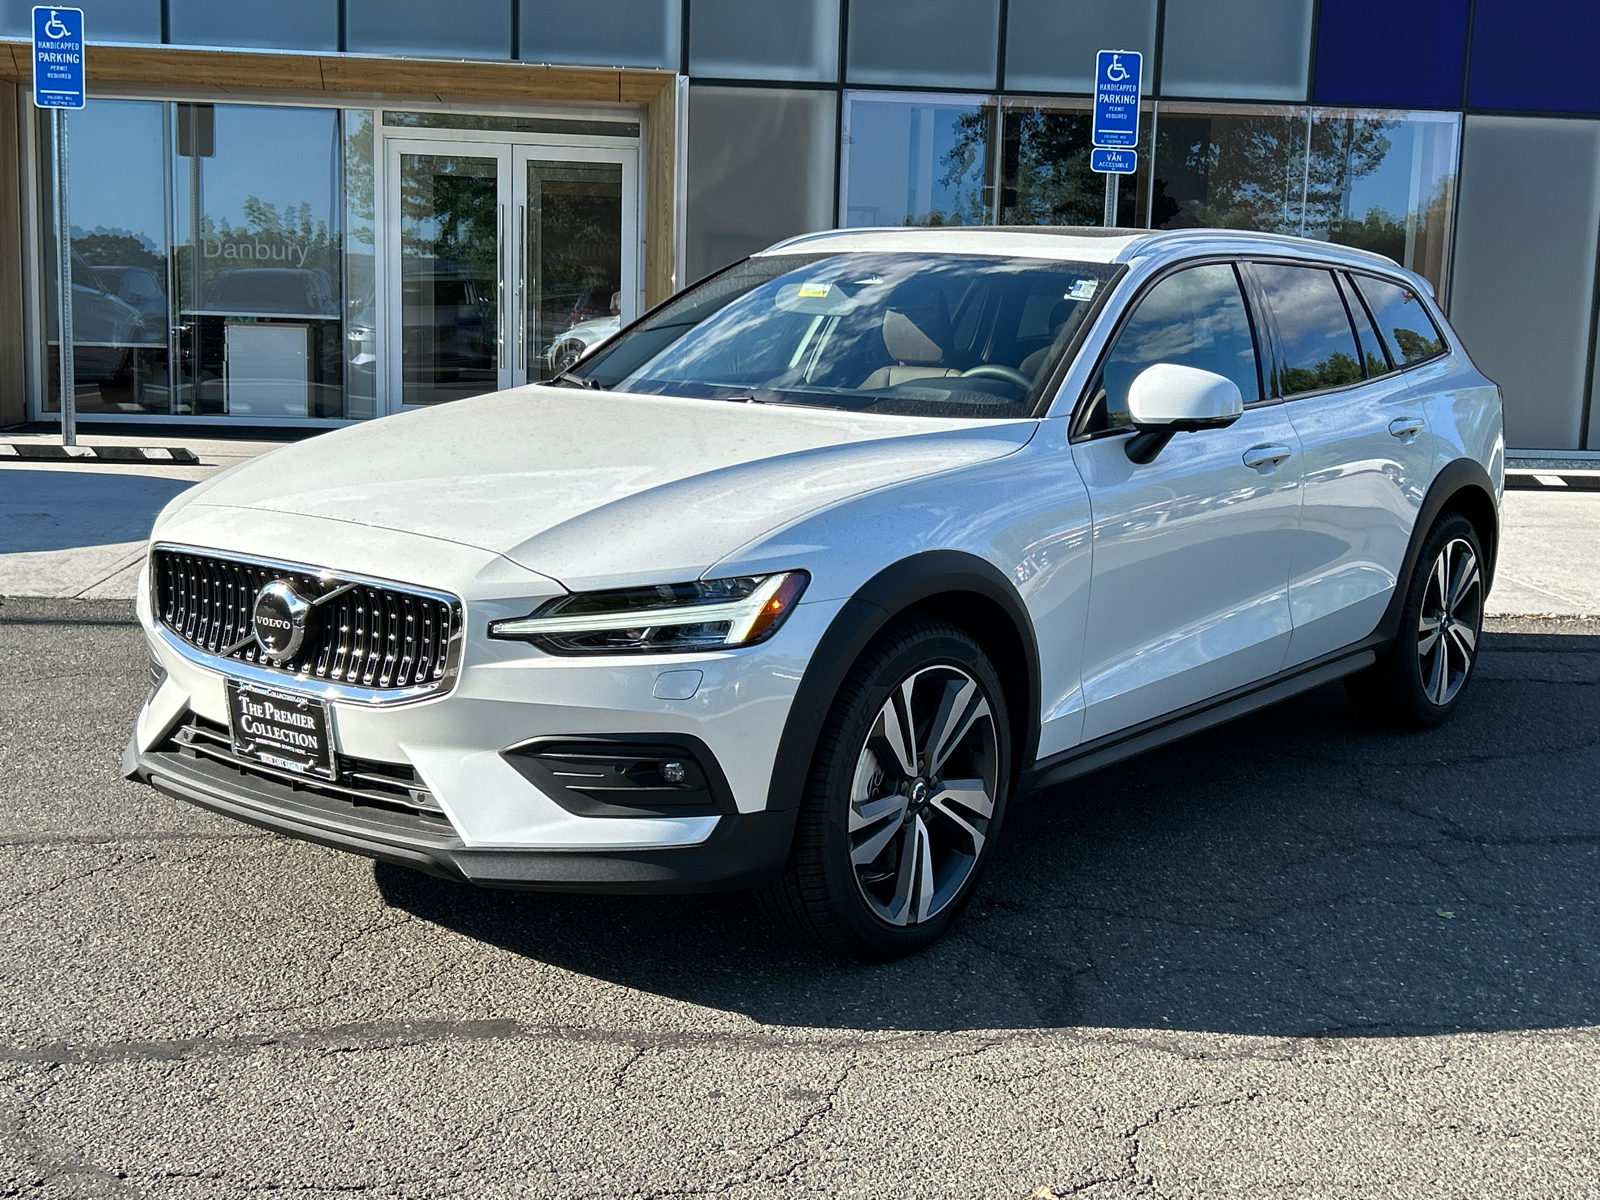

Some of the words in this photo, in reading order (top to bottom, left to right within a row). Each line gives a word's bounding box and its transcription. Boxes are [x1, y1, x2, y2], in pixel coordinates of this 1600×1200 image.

[37, 41, 80, 50] HANDICAPPED
[38, 52, 80, 64] PARKING
[1099, 83, 1137, 92] HANDICAPPED
[1099, 94, 1136, 104] PARKING
[1106, 153, 1122, 161] VAN
[1098, 161, 1129, 169] ACCESSIBLE
[203, 237, 309, 268] Danbury
[570, 243, 620, 261] WELCOM
[256, 615, 291, 630] VOLVO
